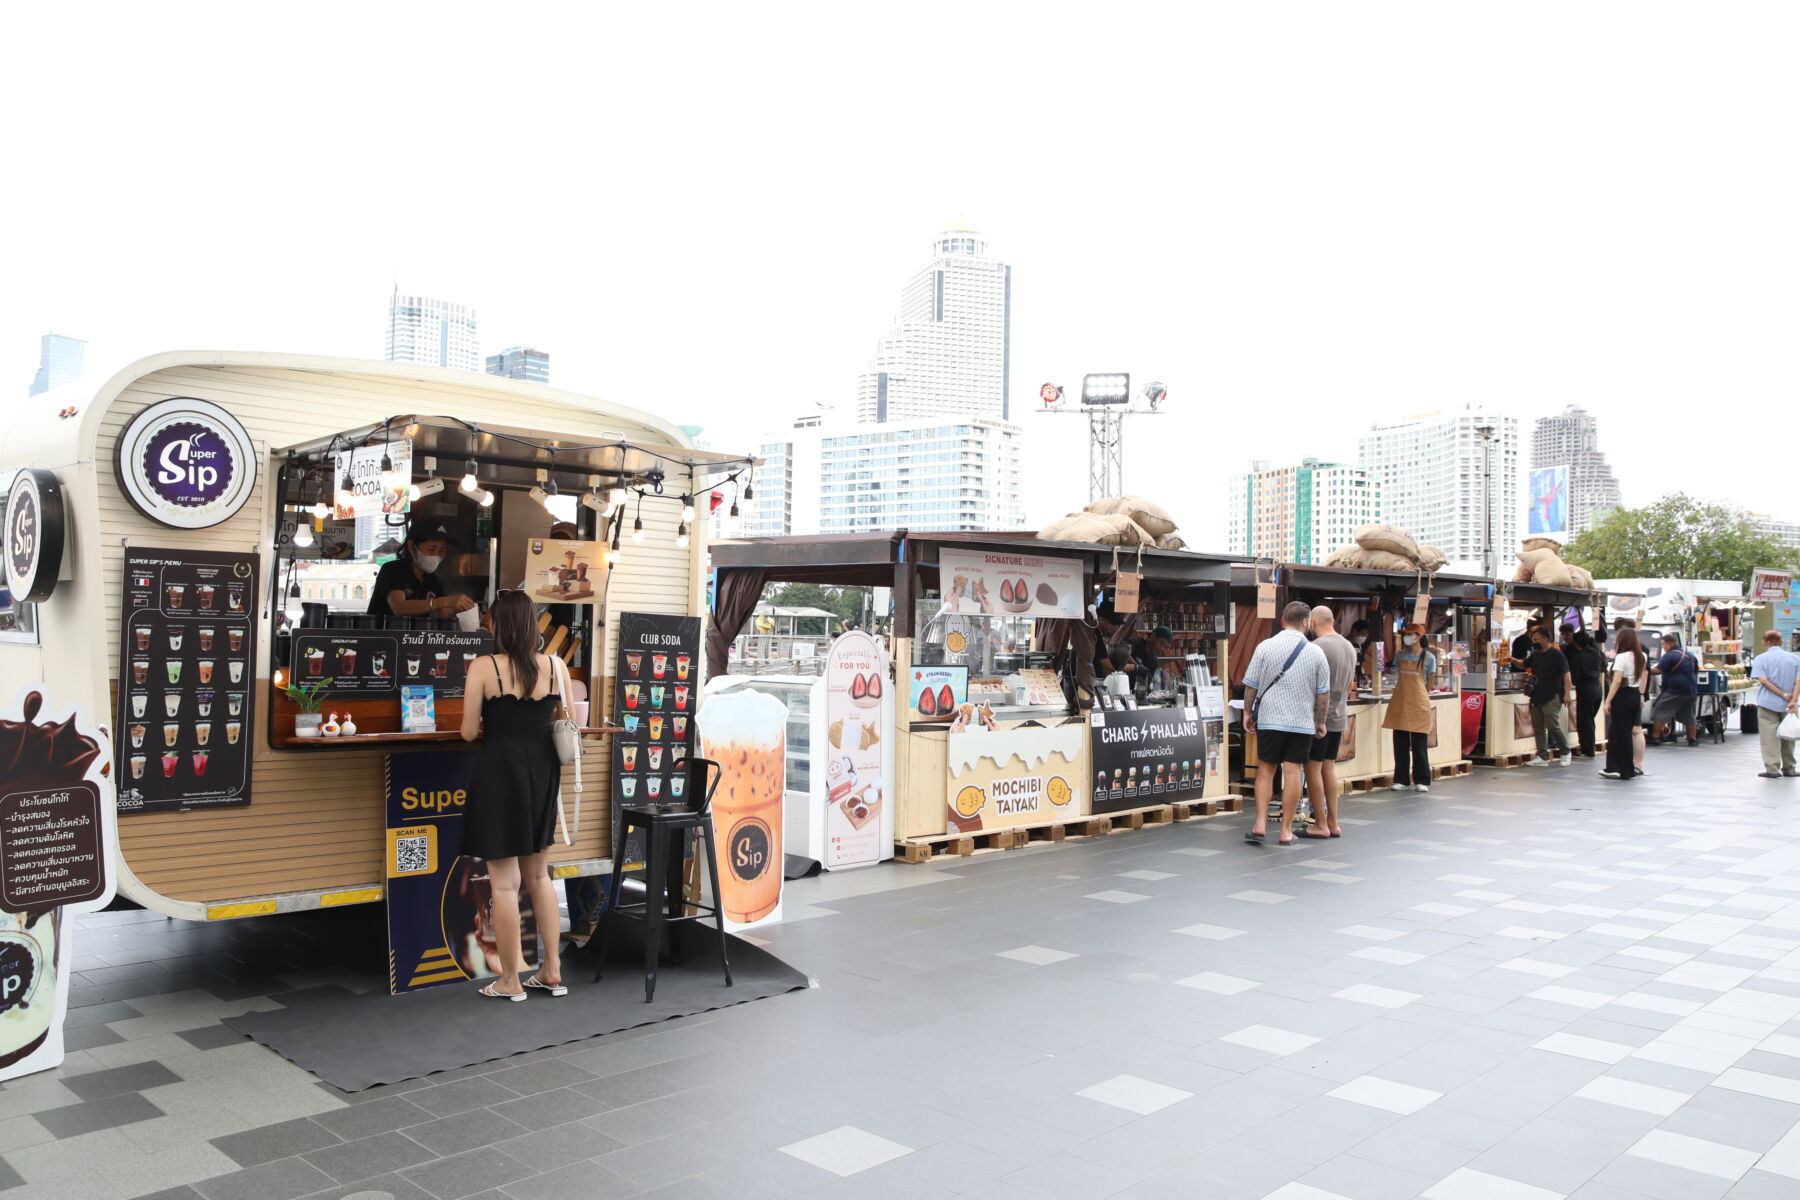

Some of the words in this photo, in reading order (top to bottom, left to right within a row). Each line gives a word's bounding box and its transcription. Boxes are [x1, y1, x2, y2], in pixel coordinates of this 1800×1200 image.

[985, 555, 1023, 566] SIGNATURE
[402, 632, 427, 645] ร้านนี้
[427, 633, 446, 645] โกโก้
[446, 636, 482, 646] อร่อยมาก
[640, 633, 659, 645] CLUB
[661, 634, 681, 646] SODA
[840, 662, 854, 670] FOR
[856, 662, 870, 670] YOU
[1101, 725, 1139, 744] CHARG
[1151, 721, 1198, 740] PHALANG
[992, 778, 1041, 797] MOCHIBI
[401, 787, 467, 812] Supe
[996, 796, 1038, 814] TAIYAKI
[396, 829, 415, 837] SCAN
[737, 837, 761, 869] Sip
